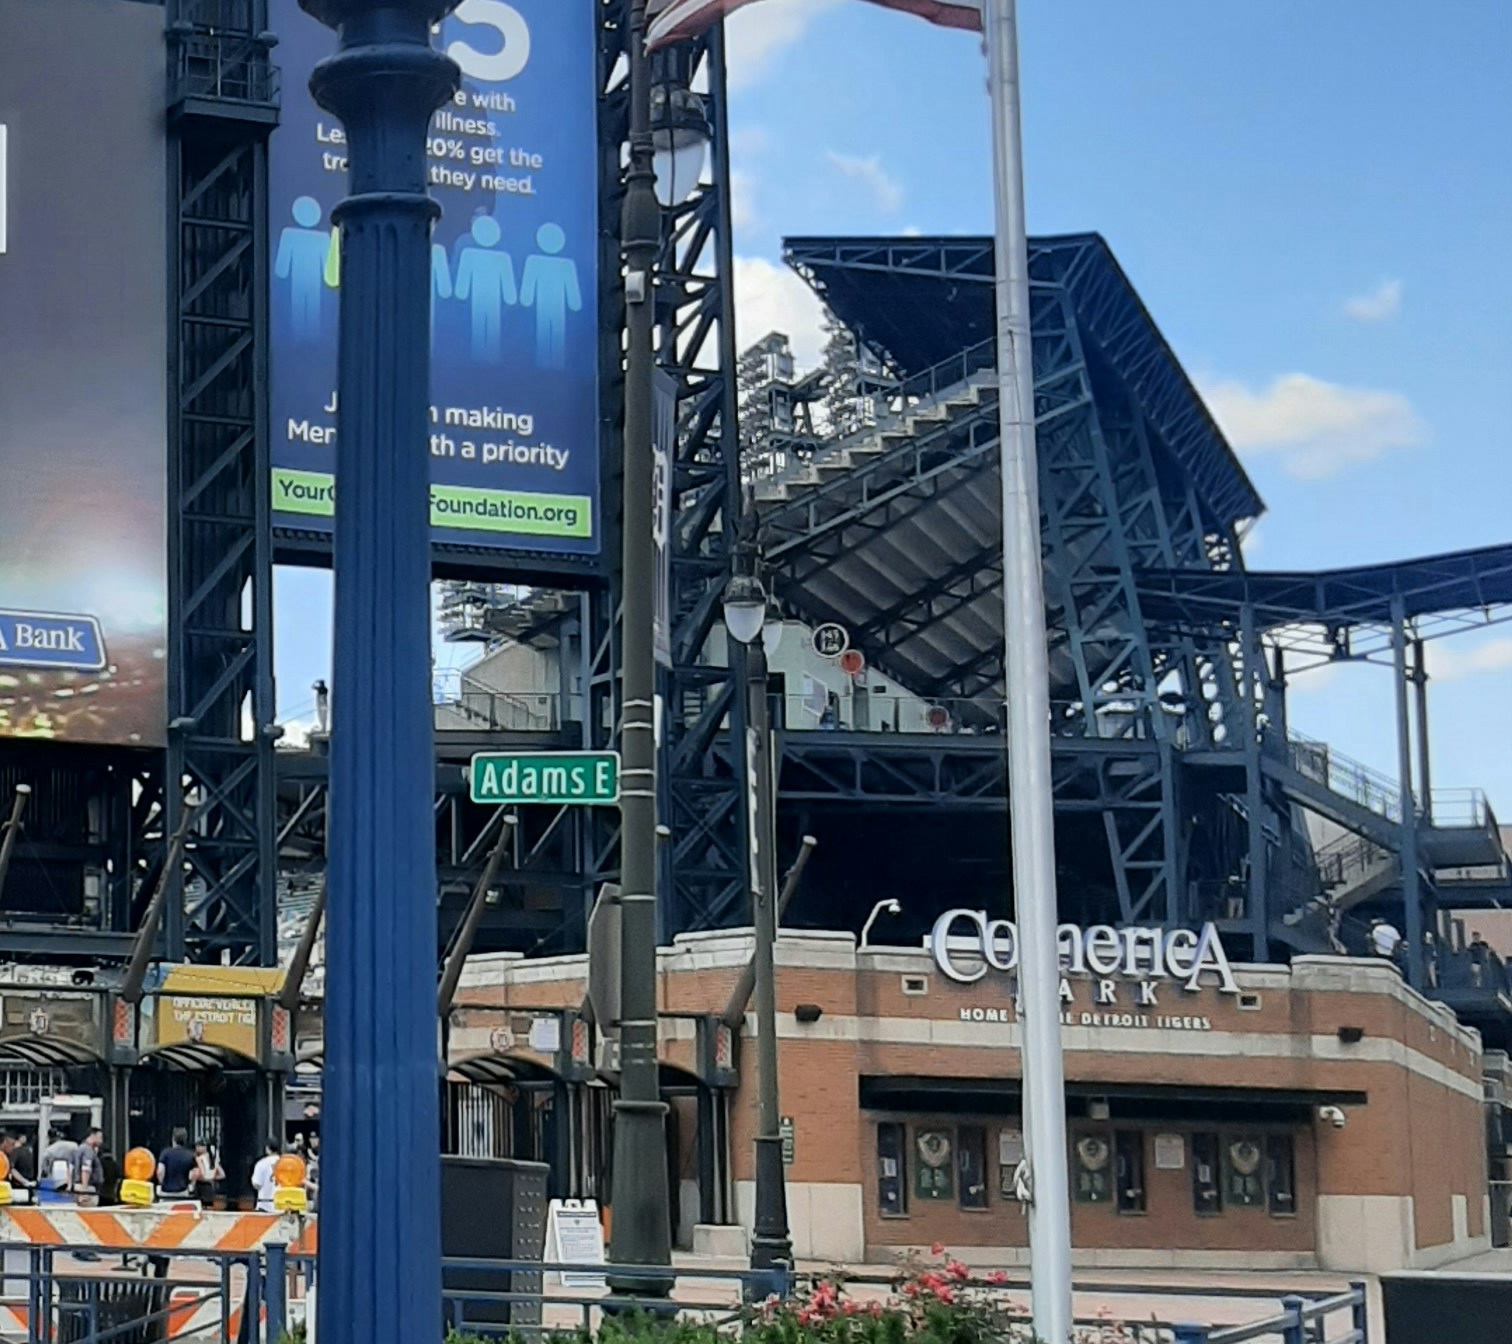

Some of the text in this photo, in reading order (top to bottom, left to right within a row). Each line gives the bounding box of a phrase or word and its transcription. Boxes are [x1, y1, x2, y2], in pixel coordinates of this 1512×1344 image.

[473, 90, 516, 113] with
[470, 143, 504, 166] get
[509, 147, 543, 169] the
[431, 165, 536, 195] they need.
[445, 406, 533, 437] making
[462, 442, 475, 459] a
[483, 441, 569, 472] priority
[279, 478, 335, 502] Your
[15, 623, 87, 653] Bank
[481, 760, 609, 796] Adams E
[1057, 978, 1159, 1007] ARK
[960, 1007, 1008, 1023] HOME
